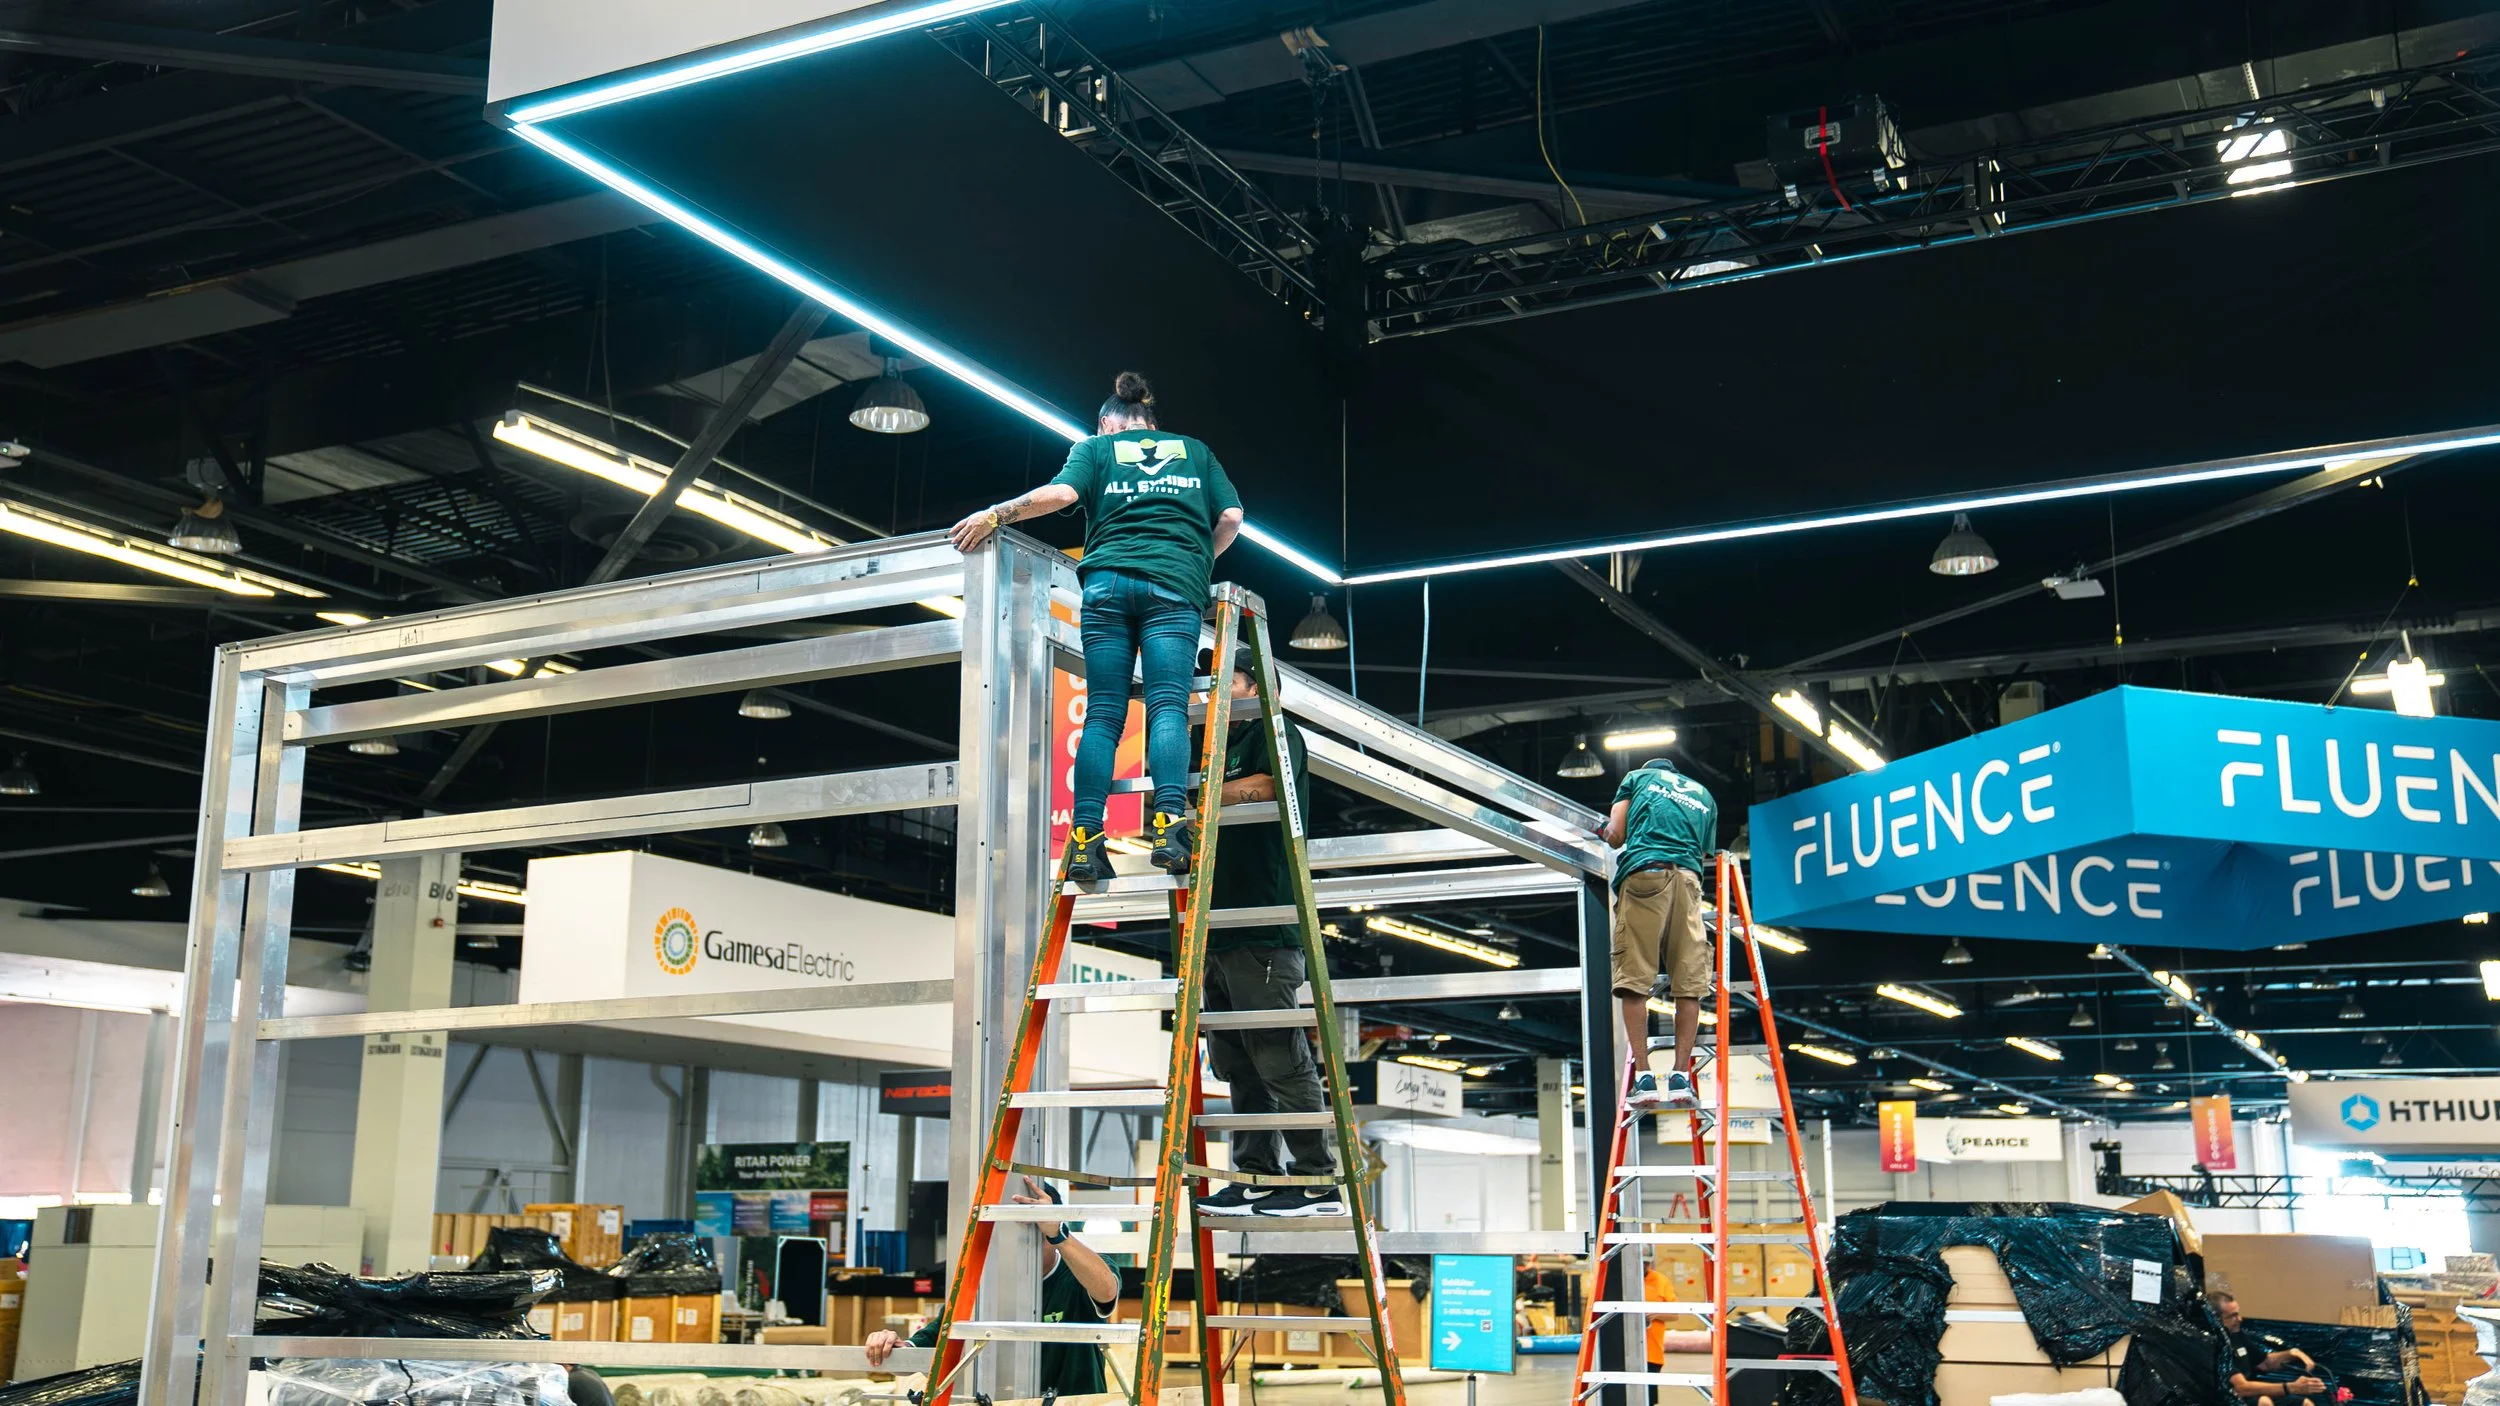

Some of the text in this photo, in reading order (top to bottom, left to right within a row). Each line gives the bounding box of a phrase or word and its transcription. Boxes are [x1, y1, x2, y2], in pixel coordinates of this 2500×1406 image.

[1103, 481, 1134, 496] ALL
[1793, 743, 2055, 885] FLUENCE
[428, 881, 454, 901] B16
[1961, 1137, 2030, 1148] PEARCE
[769, 1155, 811, 1167] POWER
